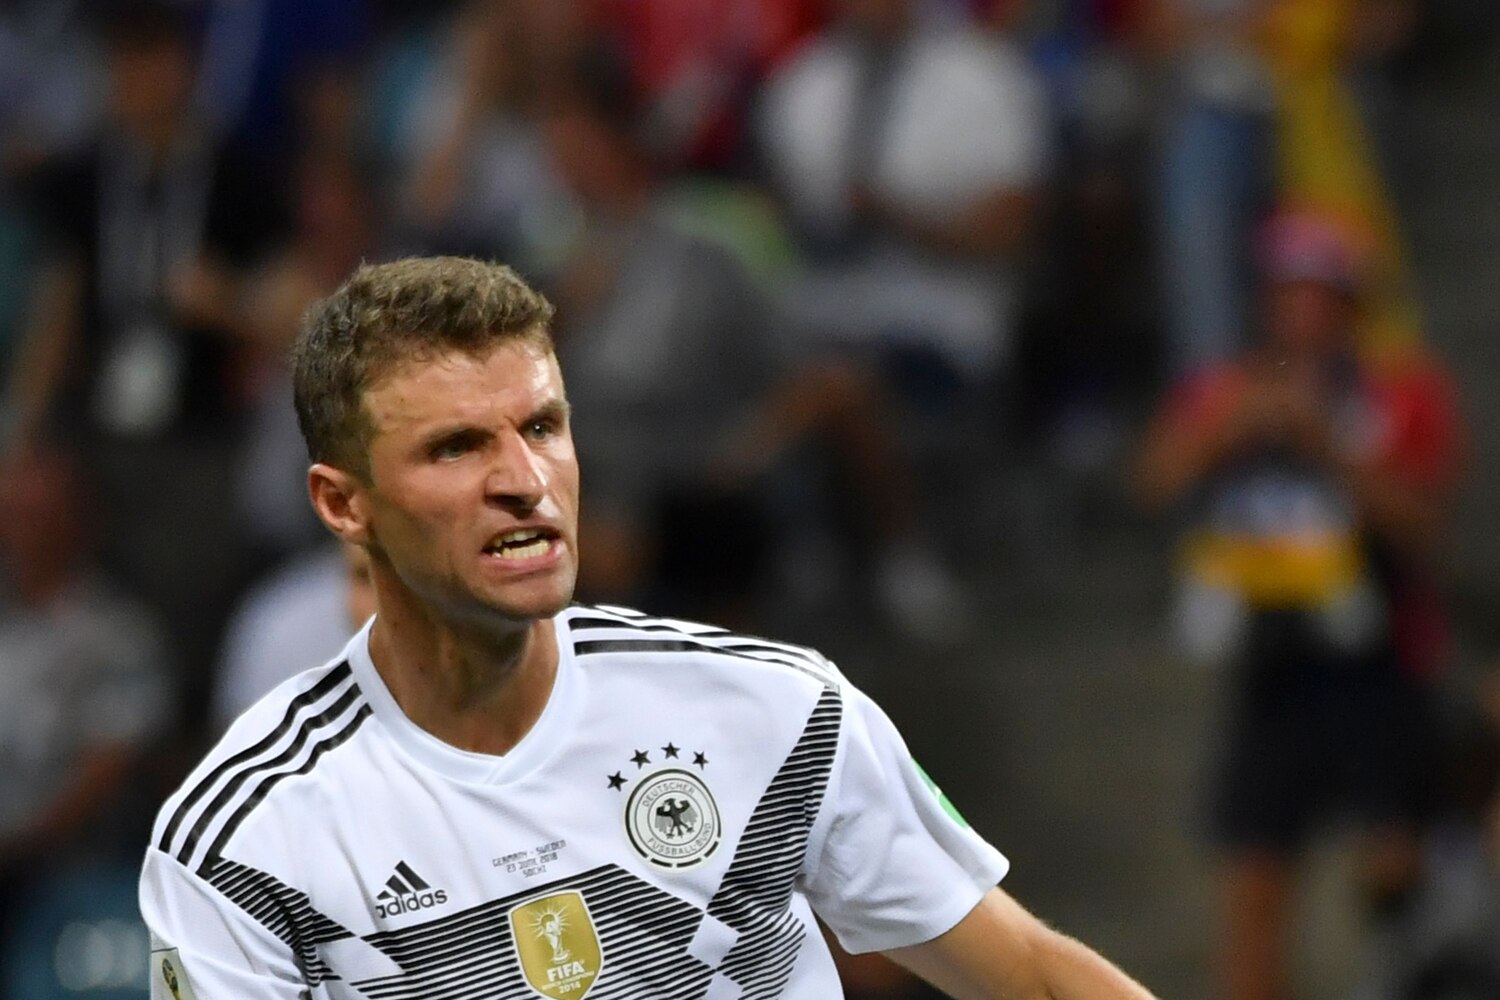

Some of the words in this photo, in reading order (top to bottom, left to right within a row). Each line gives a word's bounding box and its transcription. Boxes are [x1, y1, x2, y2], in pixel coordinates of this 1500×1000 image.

[642, 782, 695, 808] DEUTSCHER
[375, 889, 448, 919] adidas
[547, 960, 585, 982] FIFA
